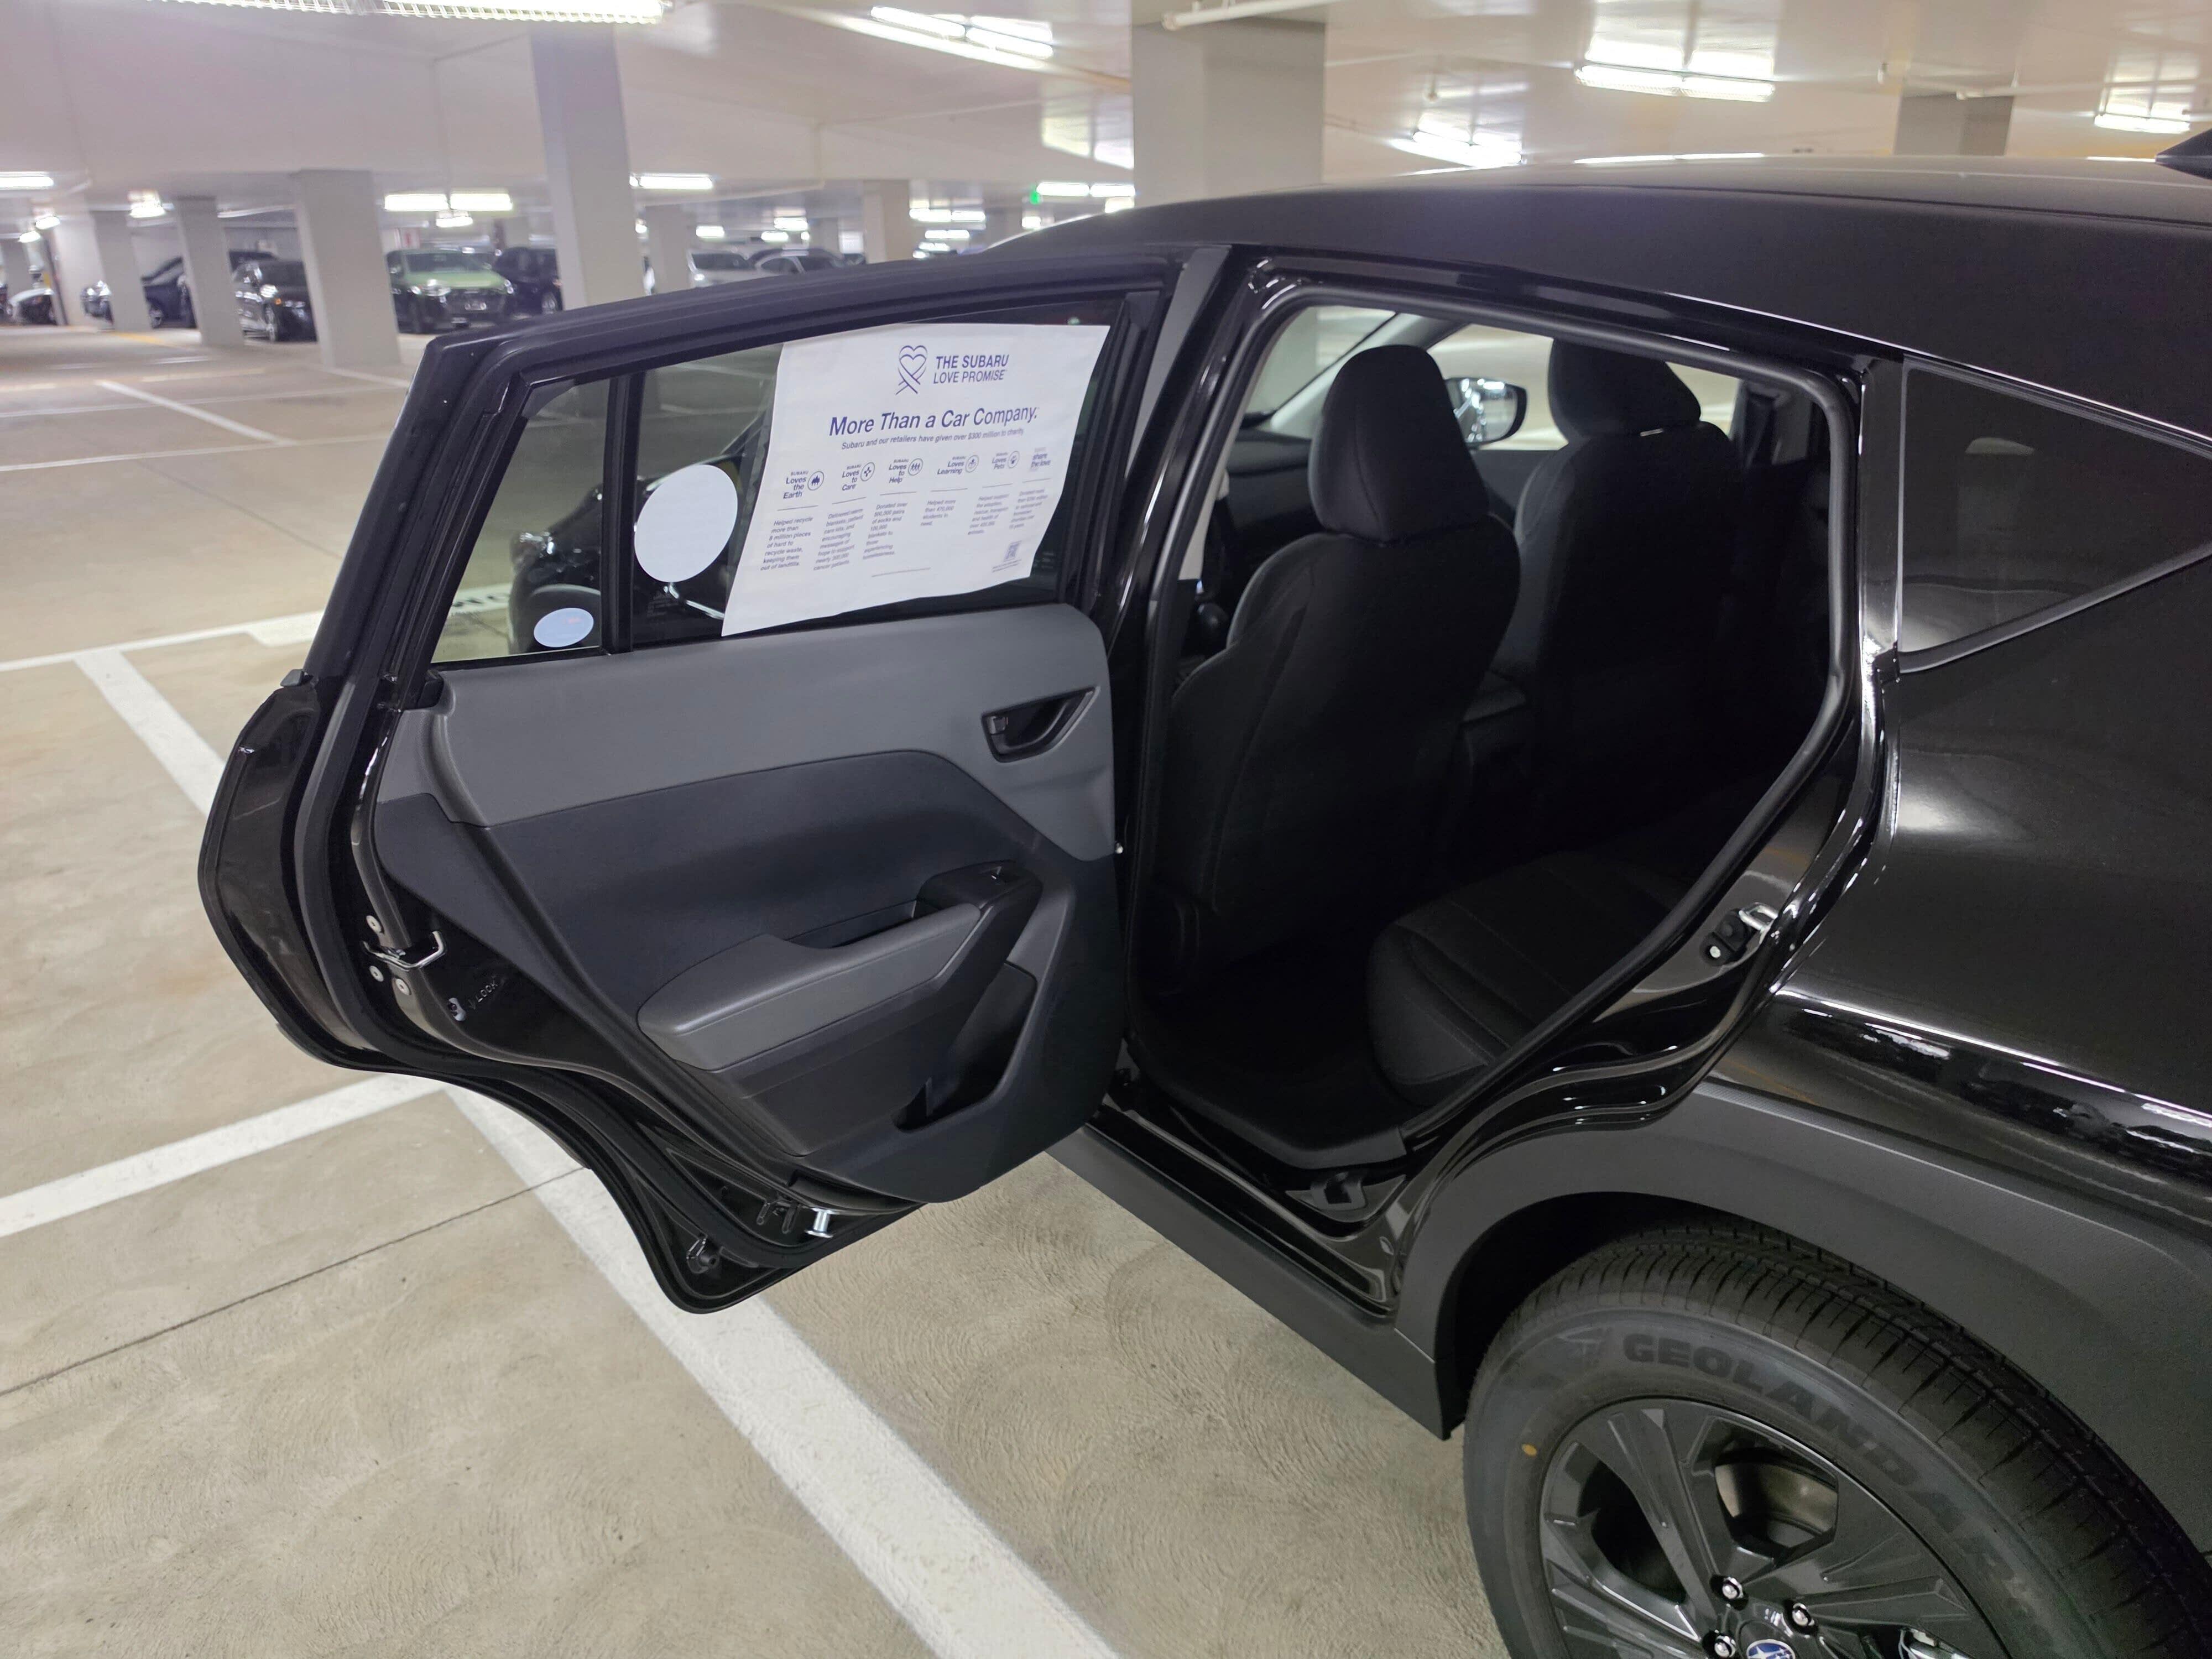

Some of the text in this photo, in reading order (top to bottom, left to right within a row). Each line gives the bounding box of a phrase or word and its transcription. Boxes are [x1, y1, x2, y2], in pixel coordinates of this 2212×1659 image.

[936, 354, 1009, 369] THE SUBARU
[933, 369, 1005, 384] LOVE PROMISE
[829, 416, 874, 436] More
[880, 412, 920, 430] Than
[925, 415, 937, 429] a
[941, 410, 970, 427] Car
[866, 438, 878, 446] and
[935, 434, 952, 443] given
[842, 470, 860, 478] Loves
